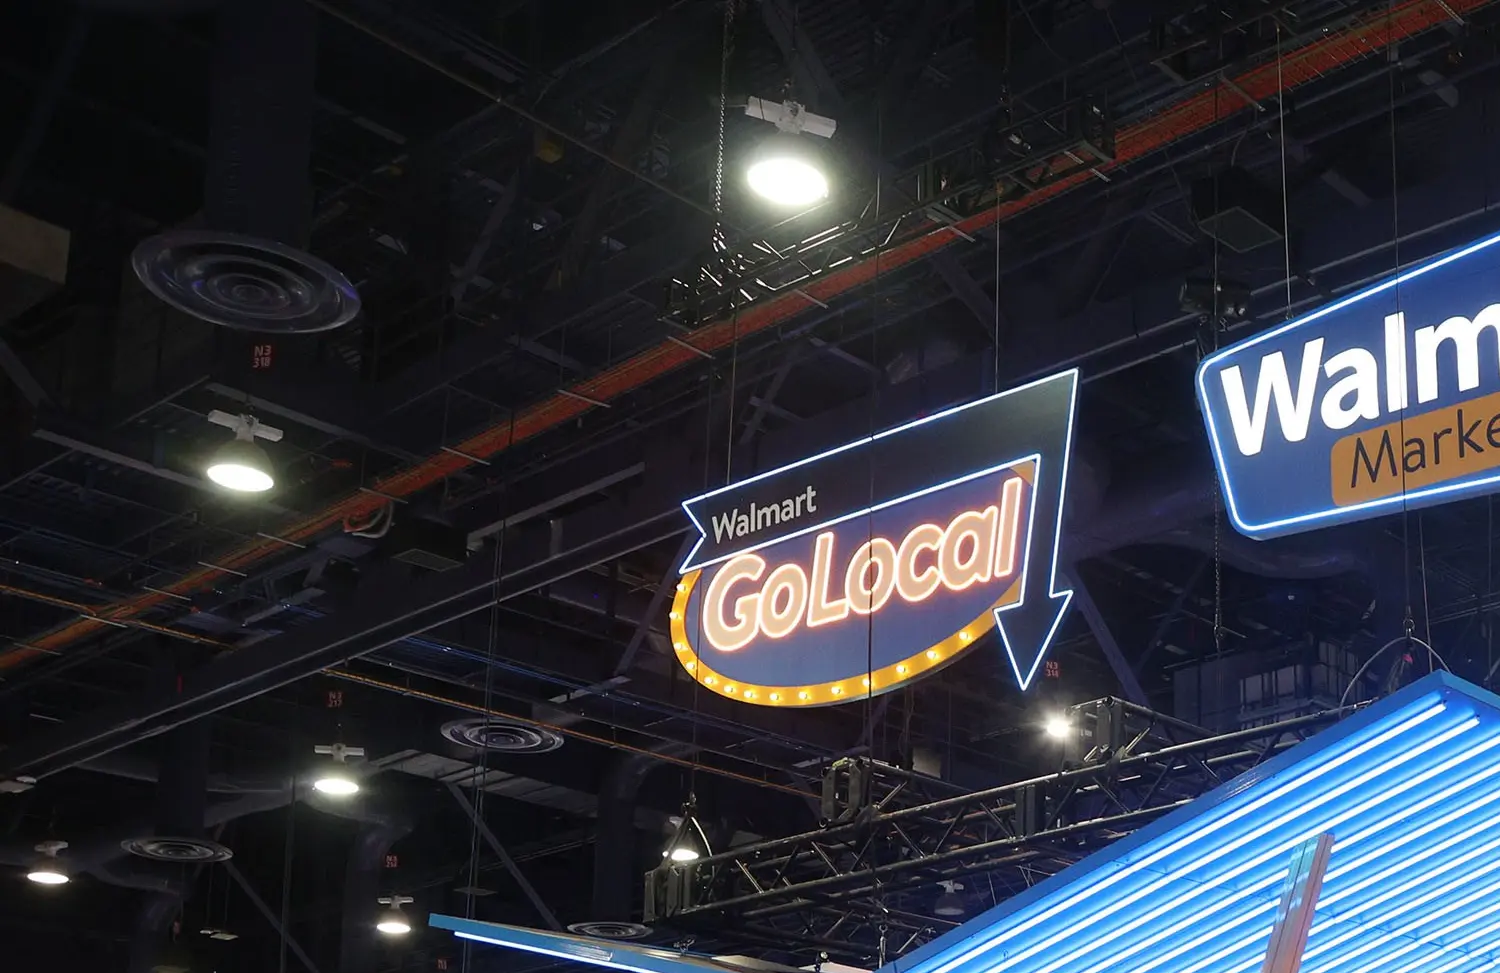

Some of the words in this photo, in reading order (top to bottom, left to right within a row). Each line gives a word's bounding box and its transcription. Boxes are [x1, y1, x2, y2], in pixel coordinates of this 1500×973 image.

[254, 345, 272, 357] N3
[711, 485, 817, 544] Walmart
[702, 476, 1022, 652] GoLocal
